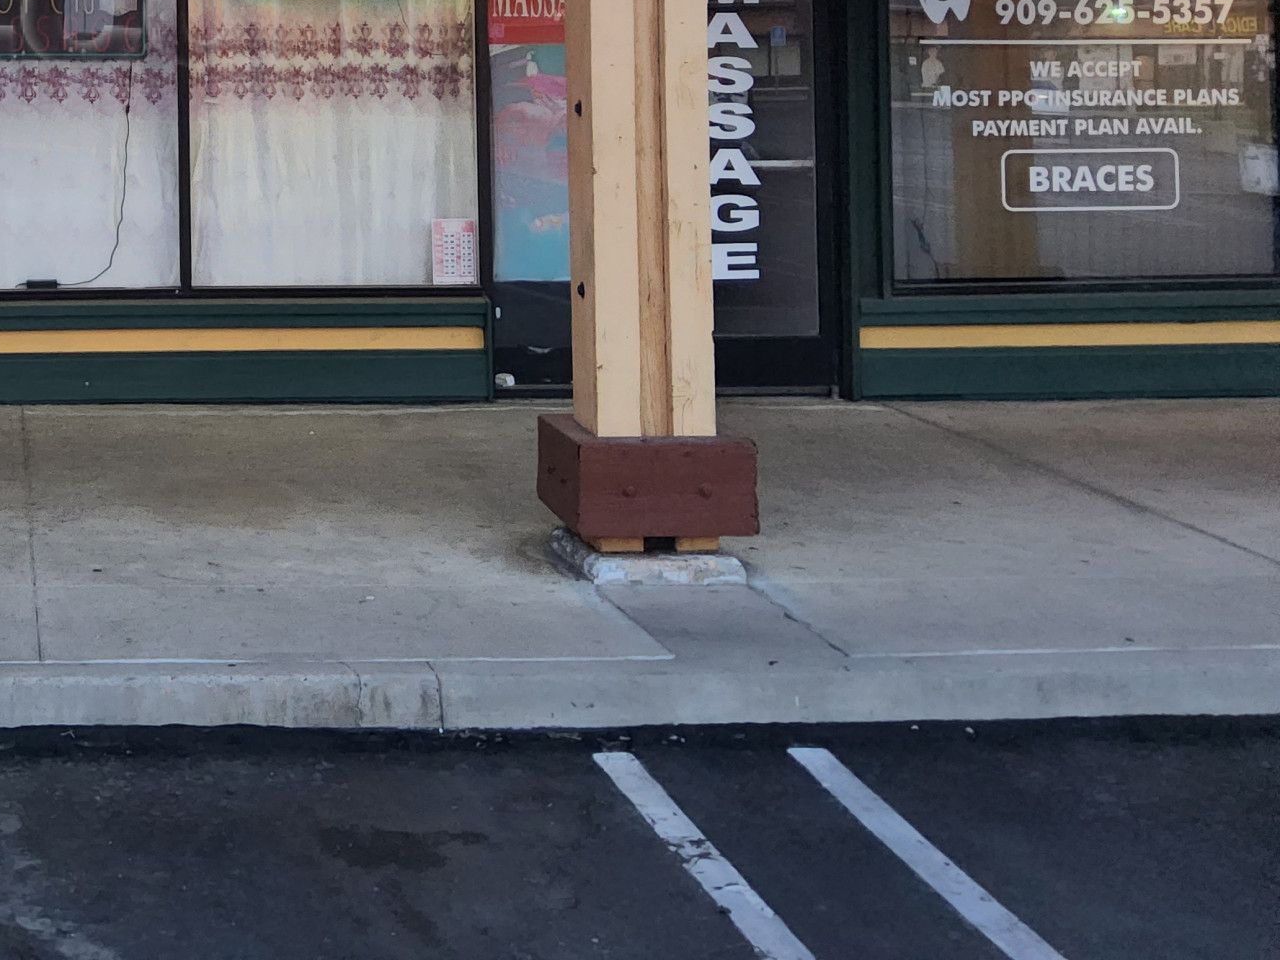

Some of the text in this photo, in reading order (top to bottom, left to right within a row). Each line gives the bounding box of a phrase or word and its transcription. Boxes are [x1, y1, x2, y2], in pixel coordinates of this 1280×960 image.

[1030, 60, 1142, 78] WE ACCEPT
[932, 88, 1240, 107] MOST PPO INSURANCE PLANS
[972, 117, 1203, 137] PAYMENT PLAN AVAIL.
[1029, 165, 1154, 192] BRACES
